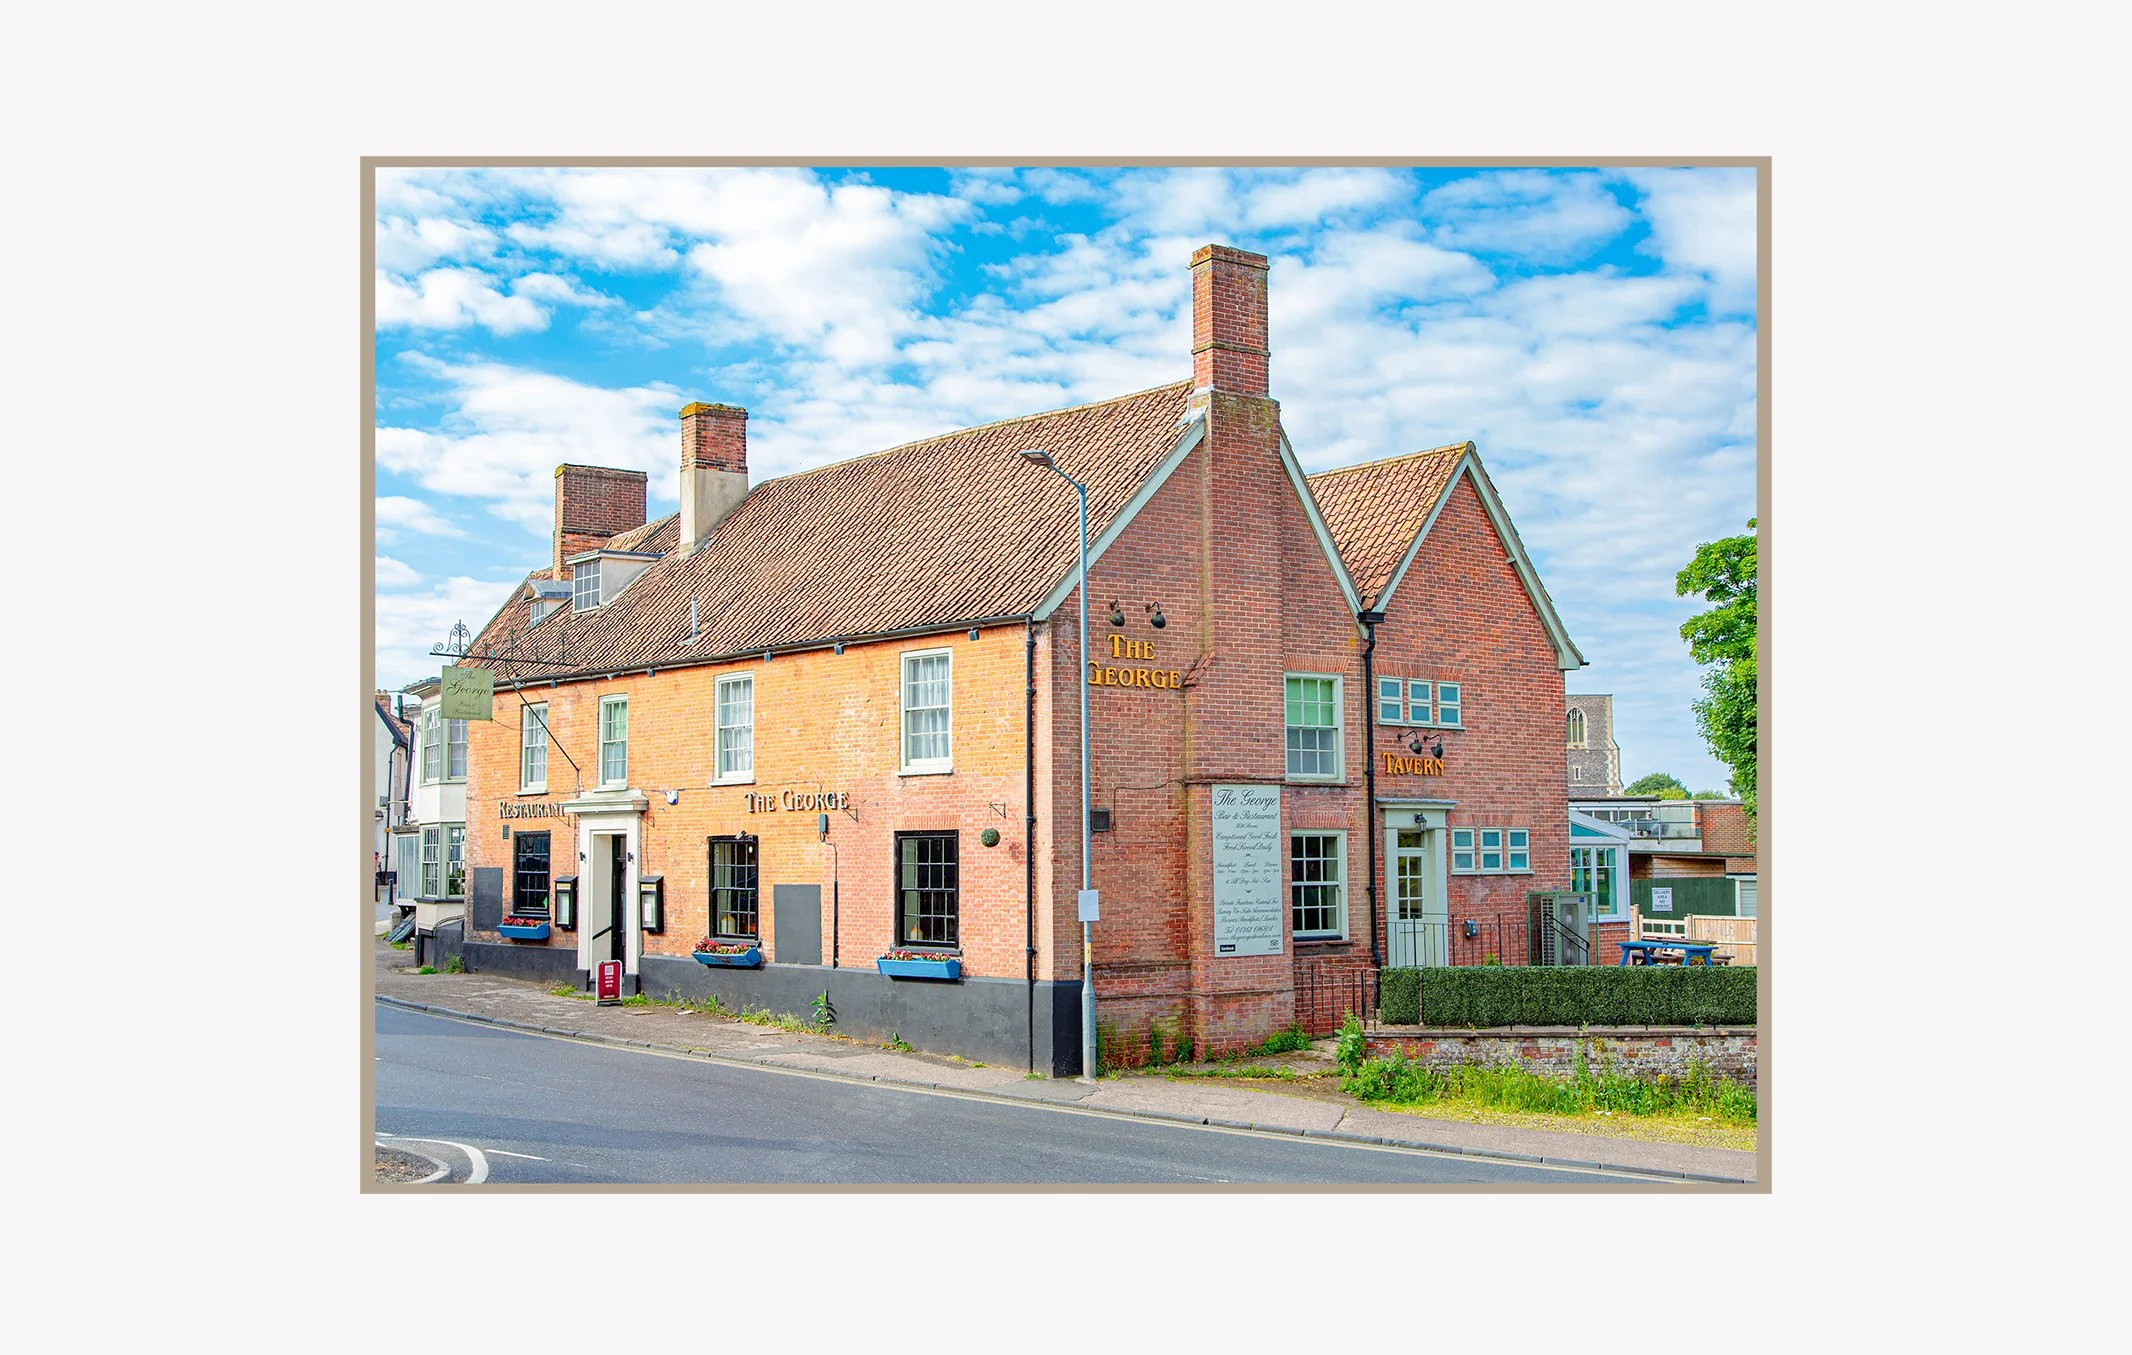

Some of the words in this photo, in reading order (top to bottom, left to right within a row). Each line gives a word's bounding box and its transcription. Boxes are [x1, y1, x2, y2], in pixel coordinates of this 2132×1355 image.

[1106, 633, 1156, 660] THE
[1088, 660, 1182, 689] GEORGE
[446, 679, 490, 700] George
[1382, 752, 1445, 776] TAVERN
[498, 800, 565, 819] RESTAURANT
[745, 792, 777, 813] THE
[782, 790, 850, 811] GEORGE
[1214, 789, 1237, 806] The
[1240, 789, 1278, 811] George
[1214, 810, 1231, 820] Bar
[1232, 812, 1239, 820] &
[1240, 810, 1278, 820] Restaurant
